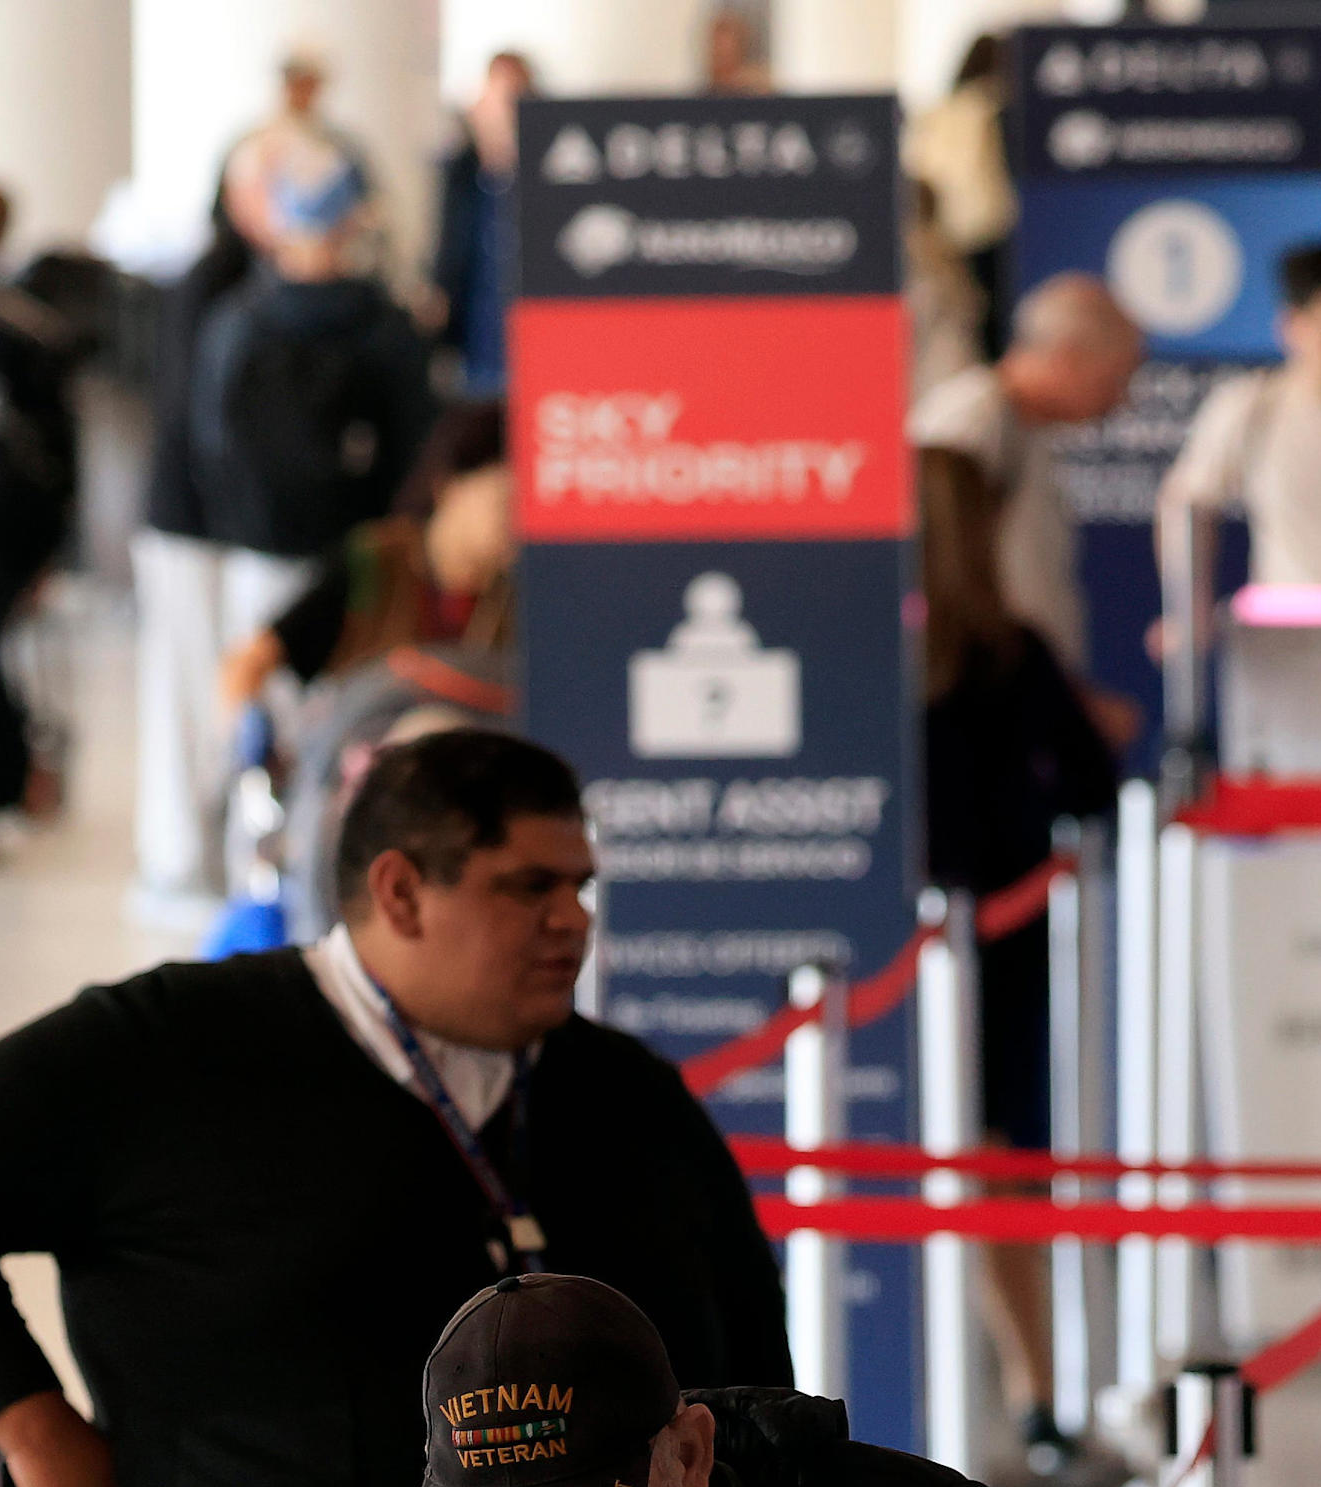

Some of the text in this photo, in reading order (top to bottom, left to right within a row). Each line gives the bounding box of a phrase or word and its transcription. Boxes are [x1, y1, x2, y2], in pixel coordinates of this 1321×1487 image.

[535, 389, 684, 442] SKY
[535, 440, 868, 502] PRIORITY
[439, 1383, 574, 1426] VIETNAM
[456, 1439, 567, 1468] VETERAN
